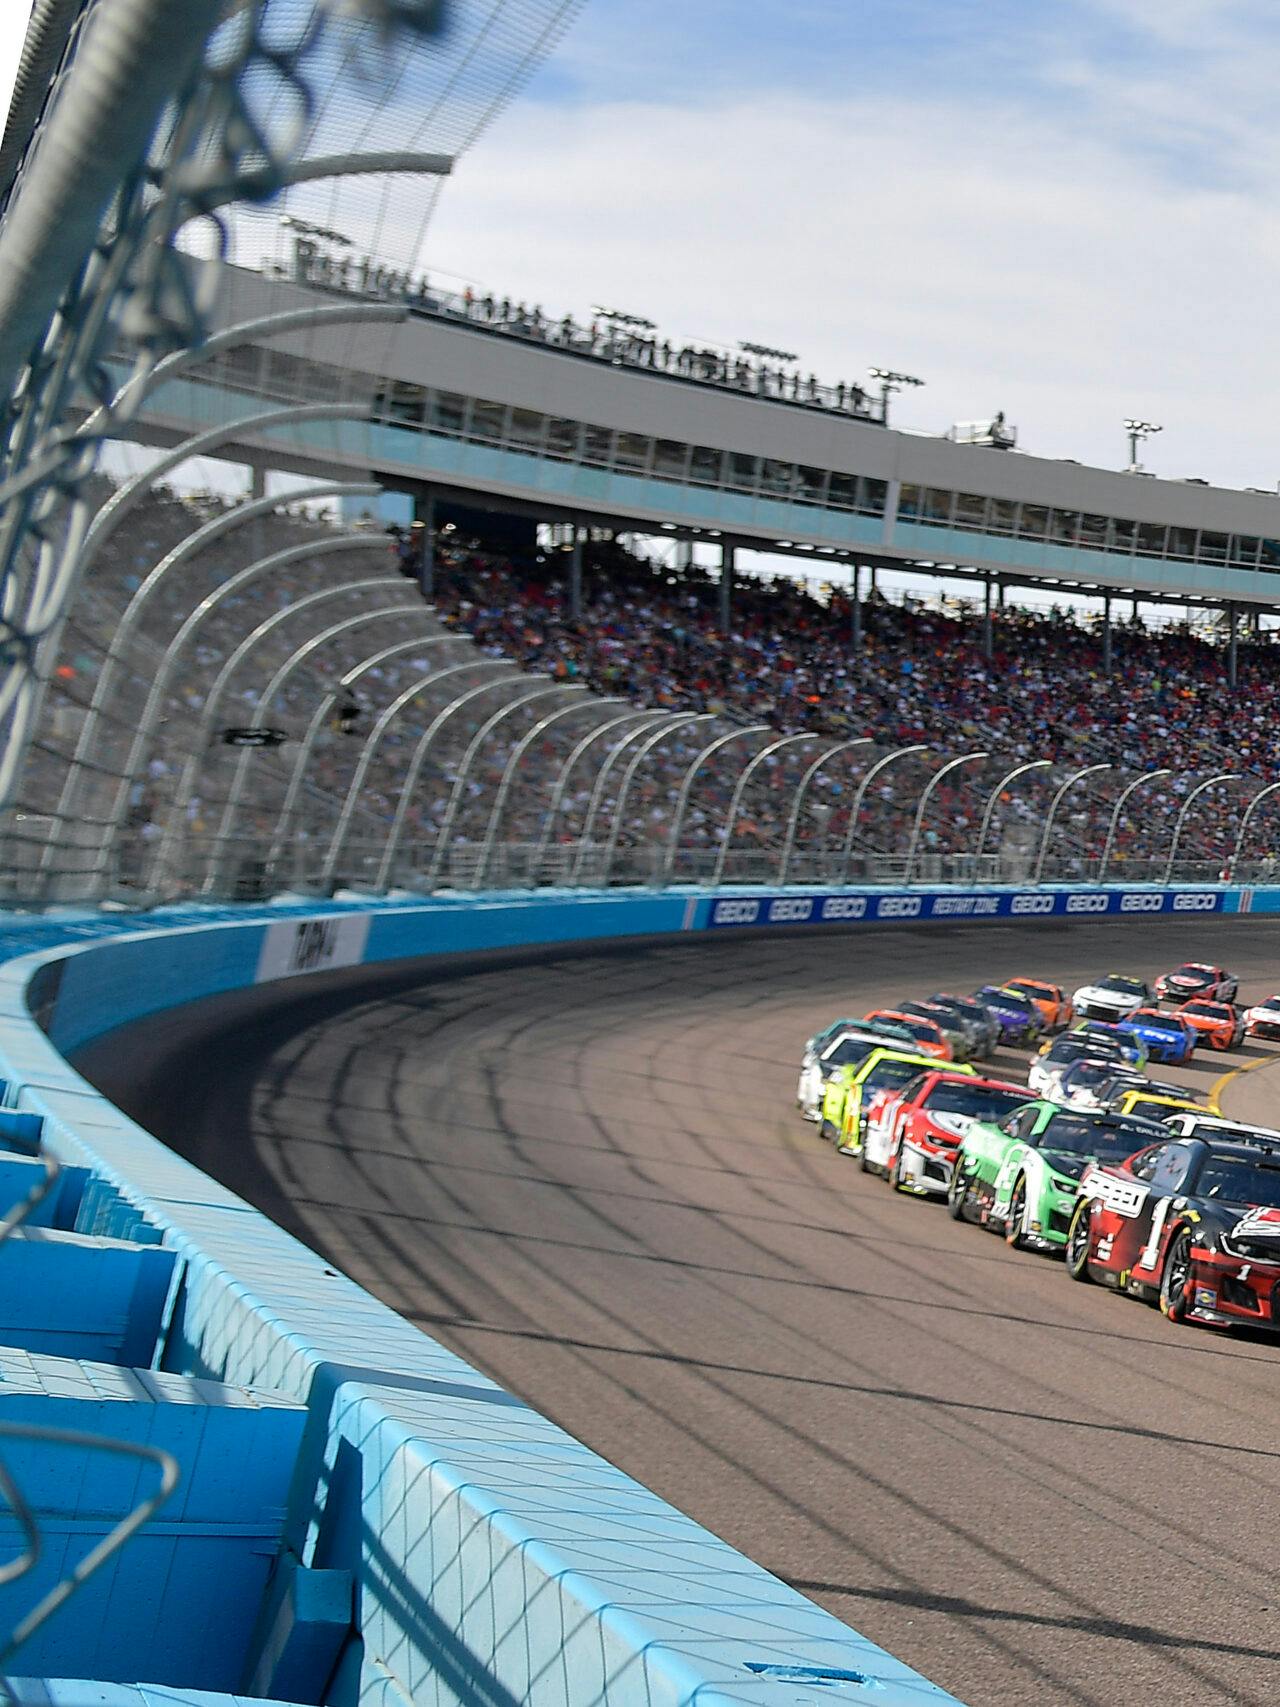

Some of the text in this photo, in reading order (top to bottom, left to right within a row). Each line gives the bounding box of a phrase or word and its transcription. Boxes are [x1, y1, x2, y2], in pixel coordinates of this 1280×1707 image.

[1010, 895, 1055, 913] GEICO
[1066, 894, 1109, 912] GEICO
[1120, 894, 1164, 911] GEICO
[1173, 894, 1216, 910] GEICO
[1236, 1265, 1251, 1281] 1
